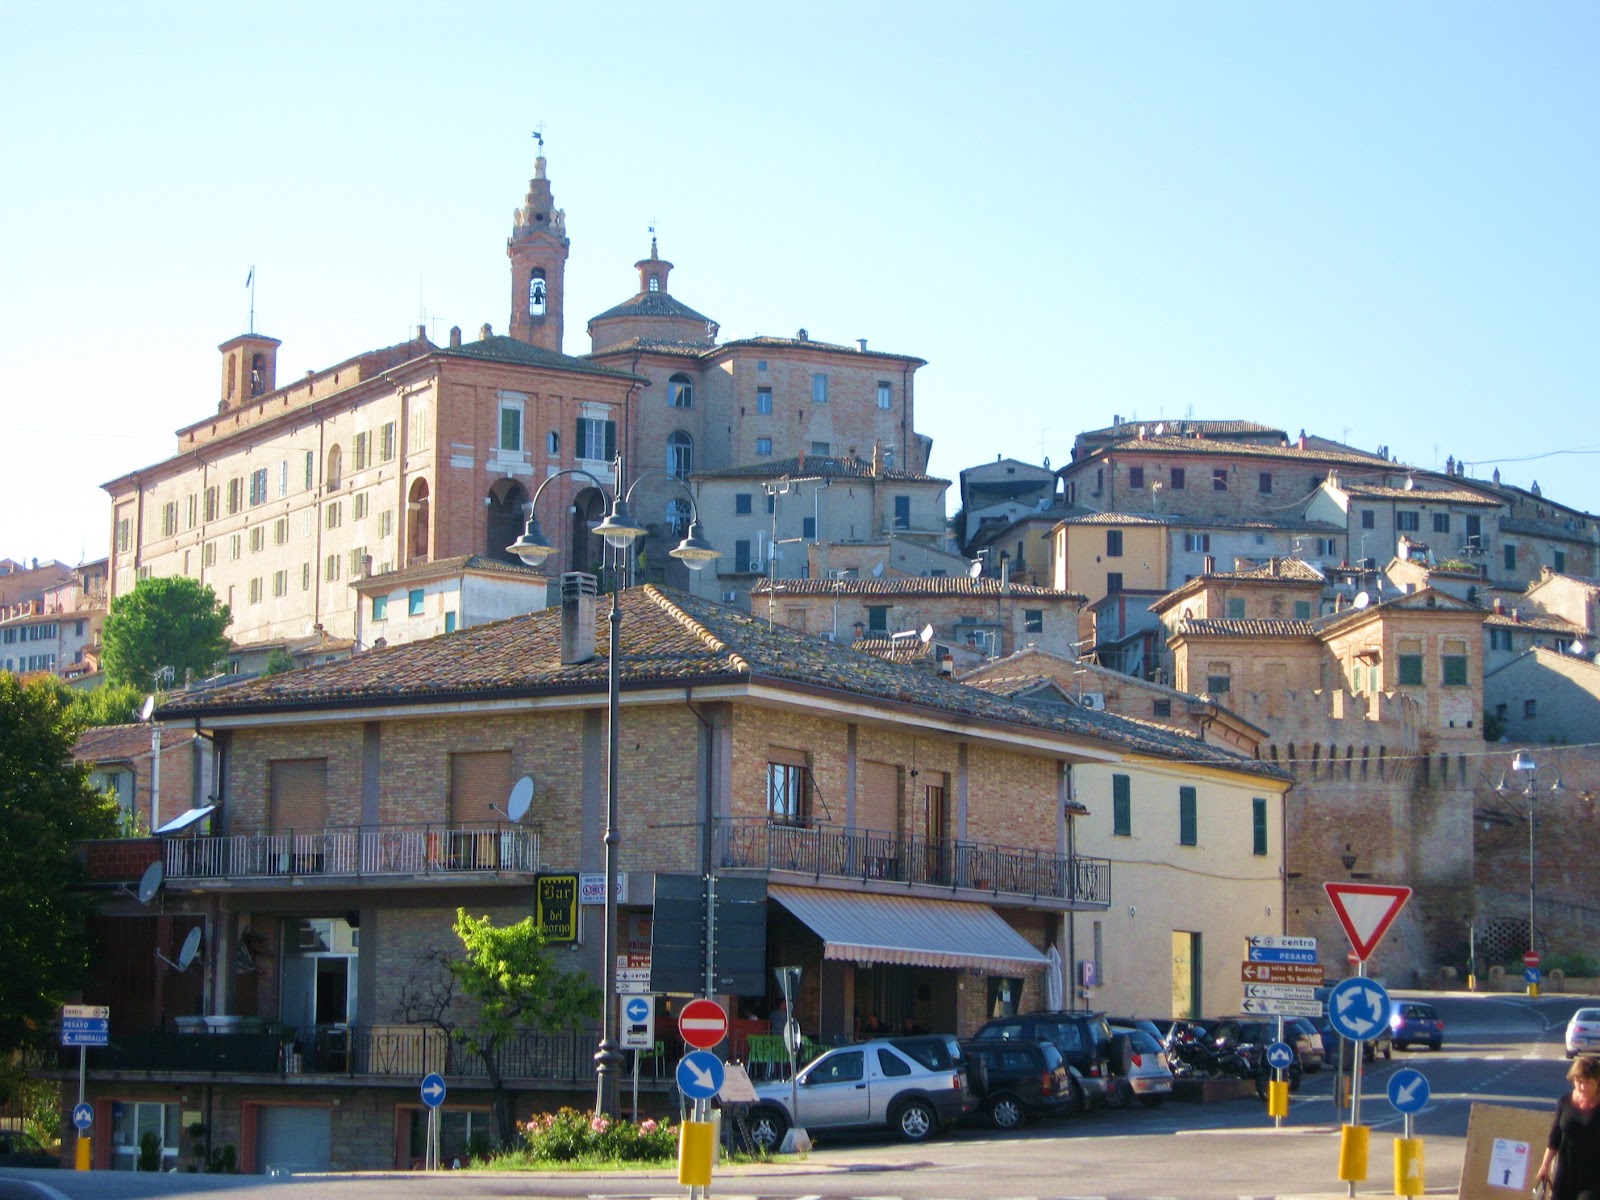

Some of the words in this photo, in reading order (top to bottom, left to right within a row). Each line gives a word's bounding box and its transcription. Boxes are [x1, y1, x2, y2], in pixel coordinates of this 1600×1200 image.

[544, 885, 571, 899] Bar
[549, 909, 562, 920] del
[1282, 939, 1314, 947] centro
[1279, 952, 1313, 961] PESARO
[1086, 963, 1093, 982] P
[75, 1034, 108, 1042] SENIGALLIA
